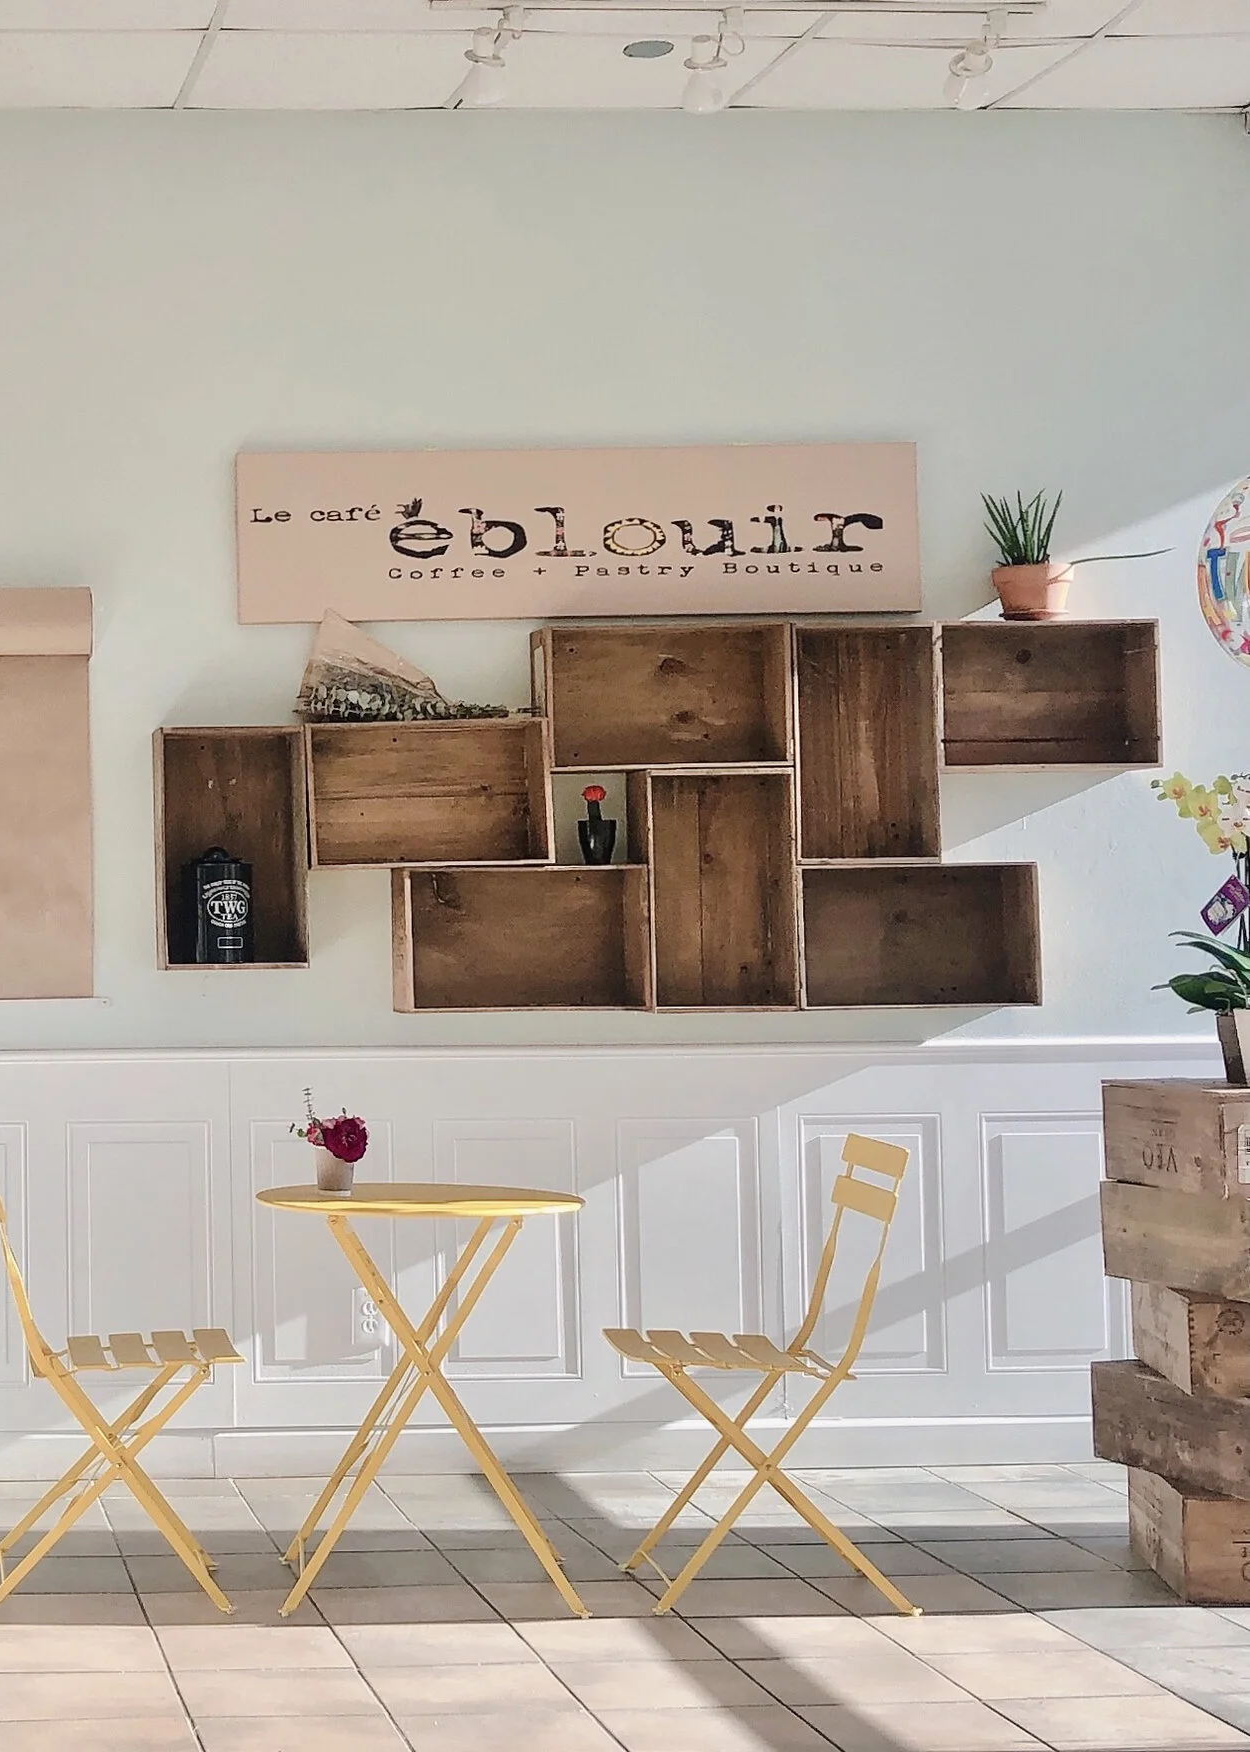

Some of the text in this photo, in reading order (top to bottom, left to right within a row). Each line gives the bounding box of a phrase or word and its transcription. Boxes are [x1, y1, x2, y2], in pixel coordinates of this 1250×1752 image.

[250, 505, 381, 522] Le café
[388, 566, 506, 580] Coffee
[574, 563, 695, 578] Pastry
[722, 562, 884, 577] Boutique
[210, 900, 246, 914] TWG
